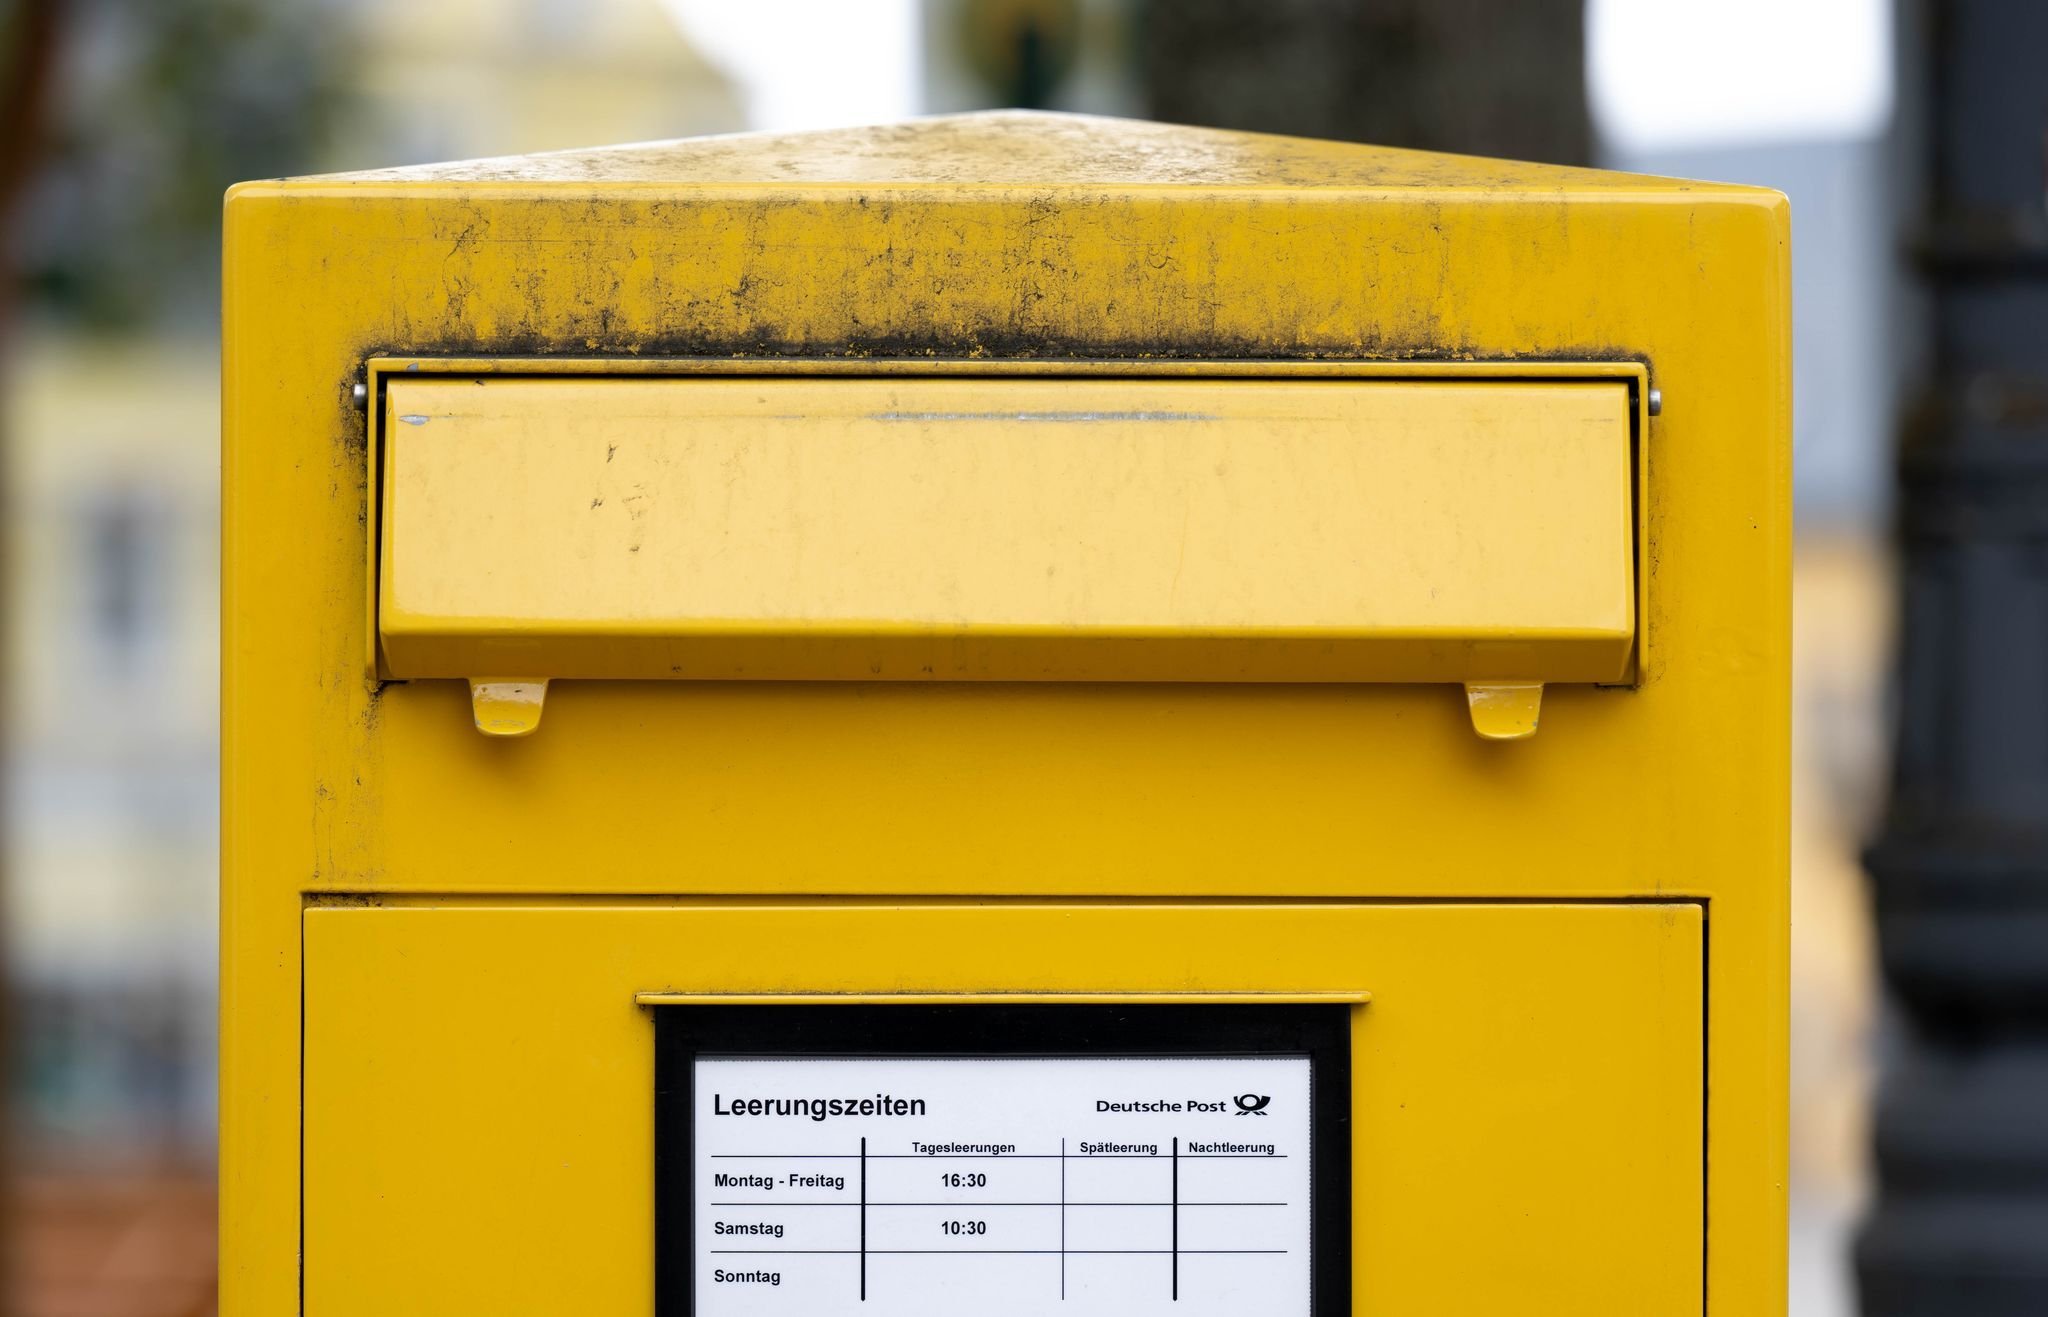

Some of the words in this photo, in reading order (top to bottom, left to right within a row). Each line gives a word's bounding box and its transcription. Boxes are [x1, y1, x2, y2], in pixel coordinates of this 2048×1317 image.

[714, 1093, 926, 1122] Leerungszeiten
[1096, 1099, 1182, 1113] Deutsche
[1187, 1100, 1227, 1113] Post
[911, 1141, 1016, 1156] Tagesleerungen
[1079, 1141, 1158, 1156] Spätleerung
[1188, 1141, 1275, 1156] Nachtleerung
[714, 1173, 774, 1191] Montag
[789, 1173, 845, 1191] Freitag
[941, 1173, 987, 1188] 16:30
[714, 1221, 784, 1239] Samstag
[941, 1220, 987, 1236] 10:30
[714, 1268, 781, 1287] Sonntag
